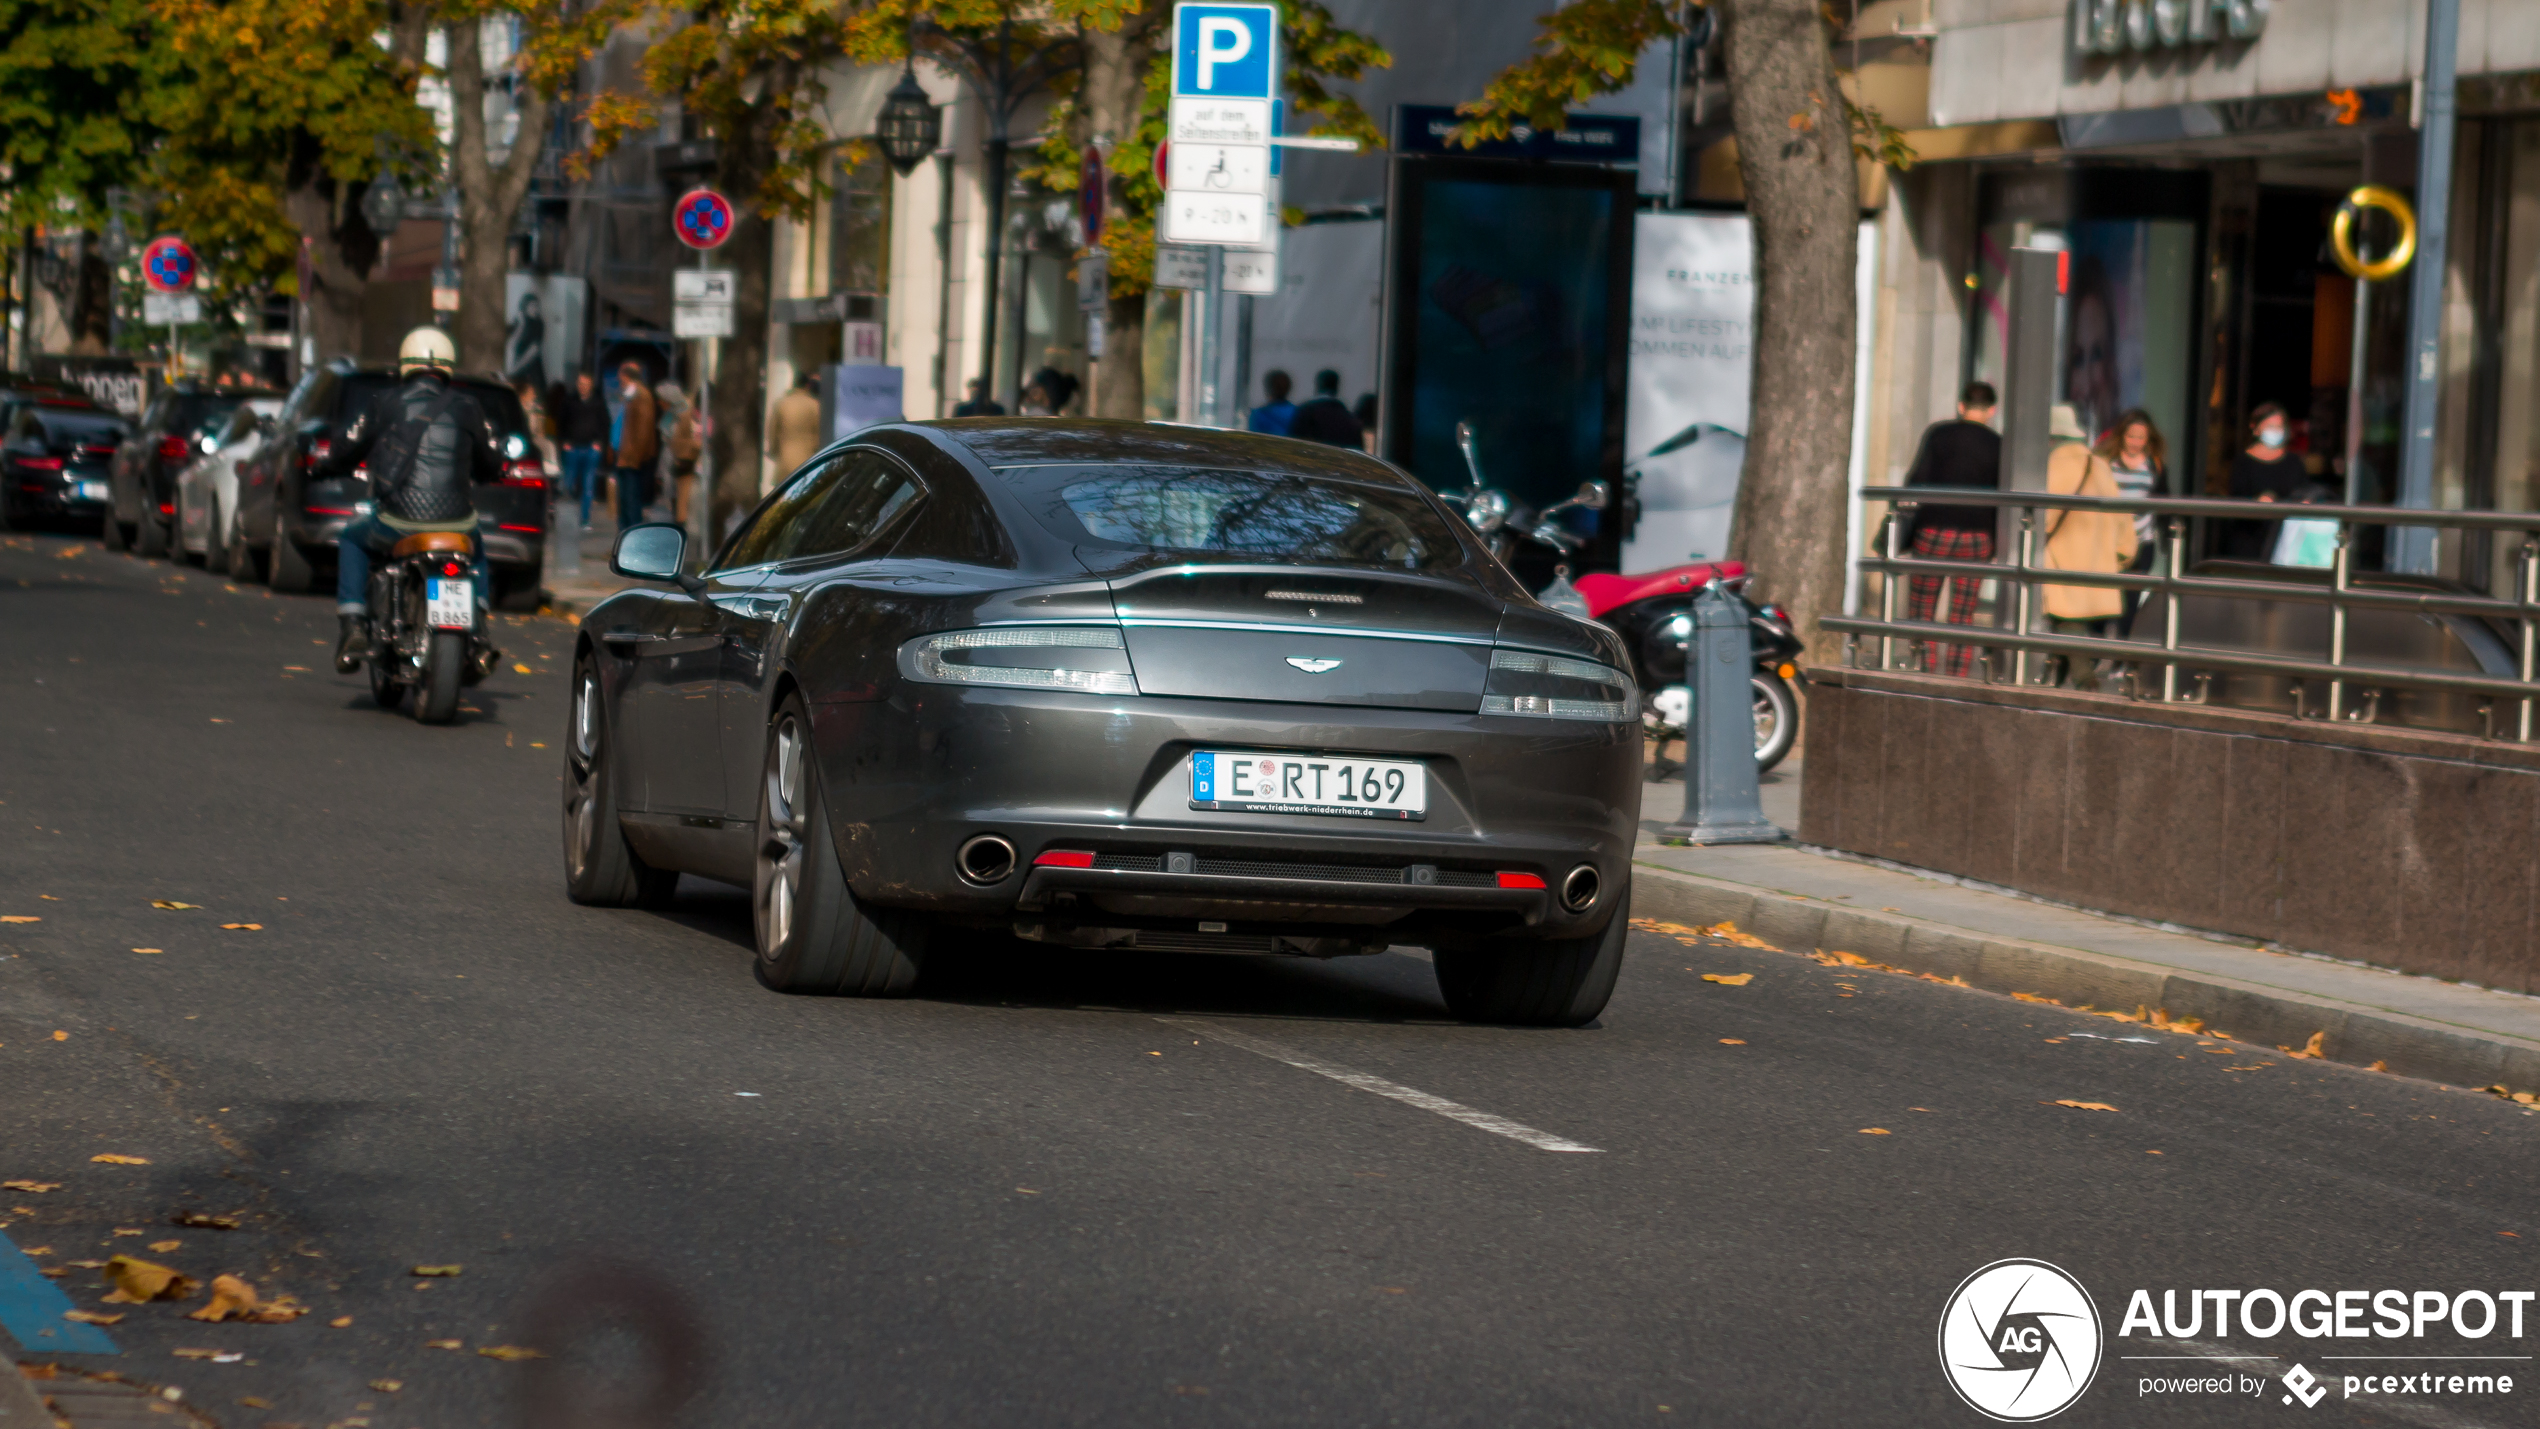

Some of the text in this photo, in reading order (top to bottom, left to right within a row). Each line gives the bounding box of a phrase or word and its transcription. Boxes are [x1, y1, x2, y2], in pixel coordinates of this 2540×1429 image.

[1196, 15, 1252, 90] P
[1668, 318, 1748, 337] LIFESTY
[1629, 340, 1706, 359] OMMEN
[443, 611, 469, 624] 865
[1232, 760, 1254, 797] E
[1282, 762, 1329, 801] RT
[1337, 766, 1405, 804] 169
[1246, 803, 1374, 816] www.triebwerk-niederrhein.de
